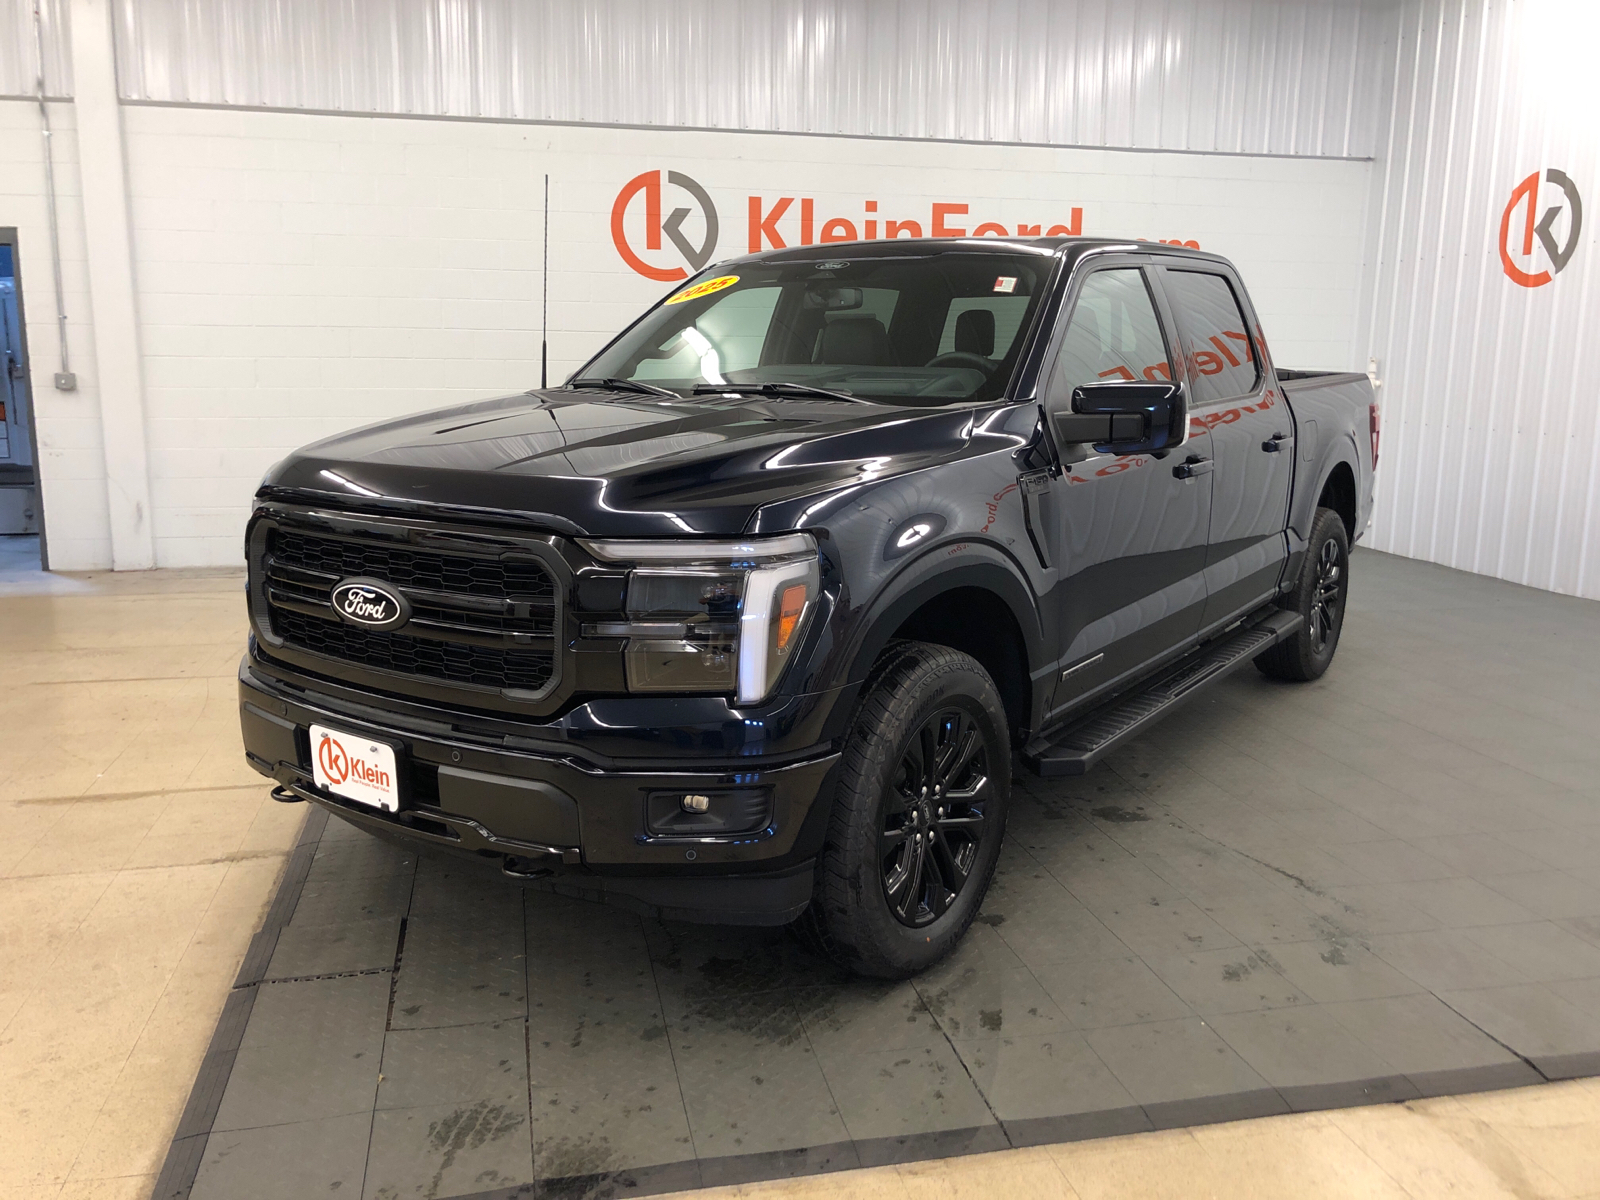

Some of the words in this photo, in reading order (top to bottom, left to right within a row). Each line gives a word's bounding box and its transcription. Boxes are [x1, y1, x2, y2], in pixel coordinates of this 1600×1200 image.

[671, 277, 733, 303] 2025
[345, 588, 386, 619] Ford
[350, 757, 390, 787] Klein
